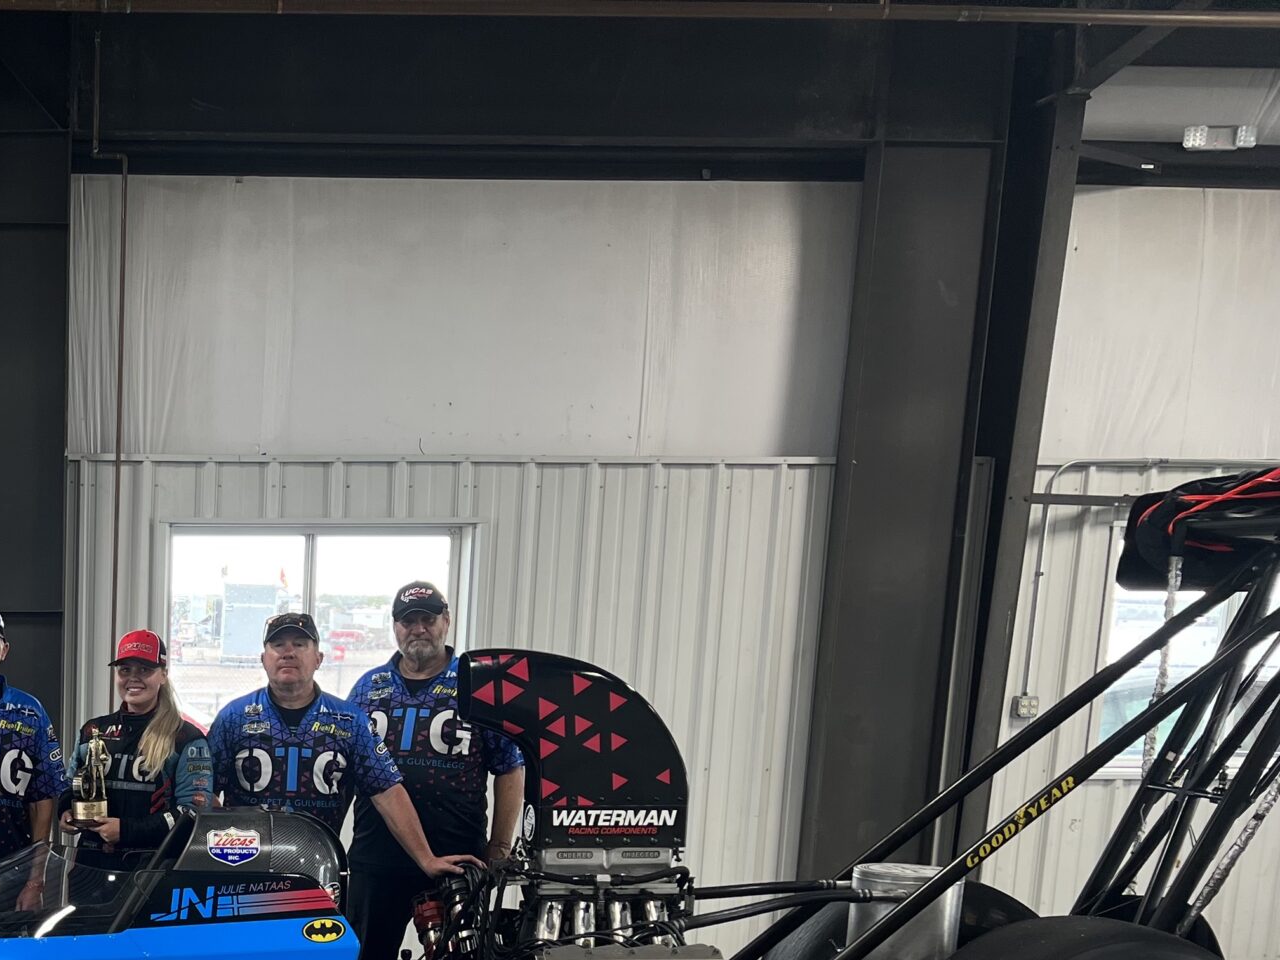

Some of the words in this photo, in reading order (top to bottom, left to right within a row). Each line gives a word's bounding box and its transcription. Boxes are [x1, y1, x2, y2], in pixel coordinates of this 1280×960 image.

[235, 746, 348, 795] OTG
[552, 809, 677, 826] WATERMAN
[966, 775, 1076, 868] GOODYEAR
[568, 827, 599, 835] RACING
[600, 827, 658, 835] COMPONENTS
[214, 837, 256, 846] LUCAS
[217, 884, 246, 895] JULIE
[249, 880, 292, 893] NATAAS
